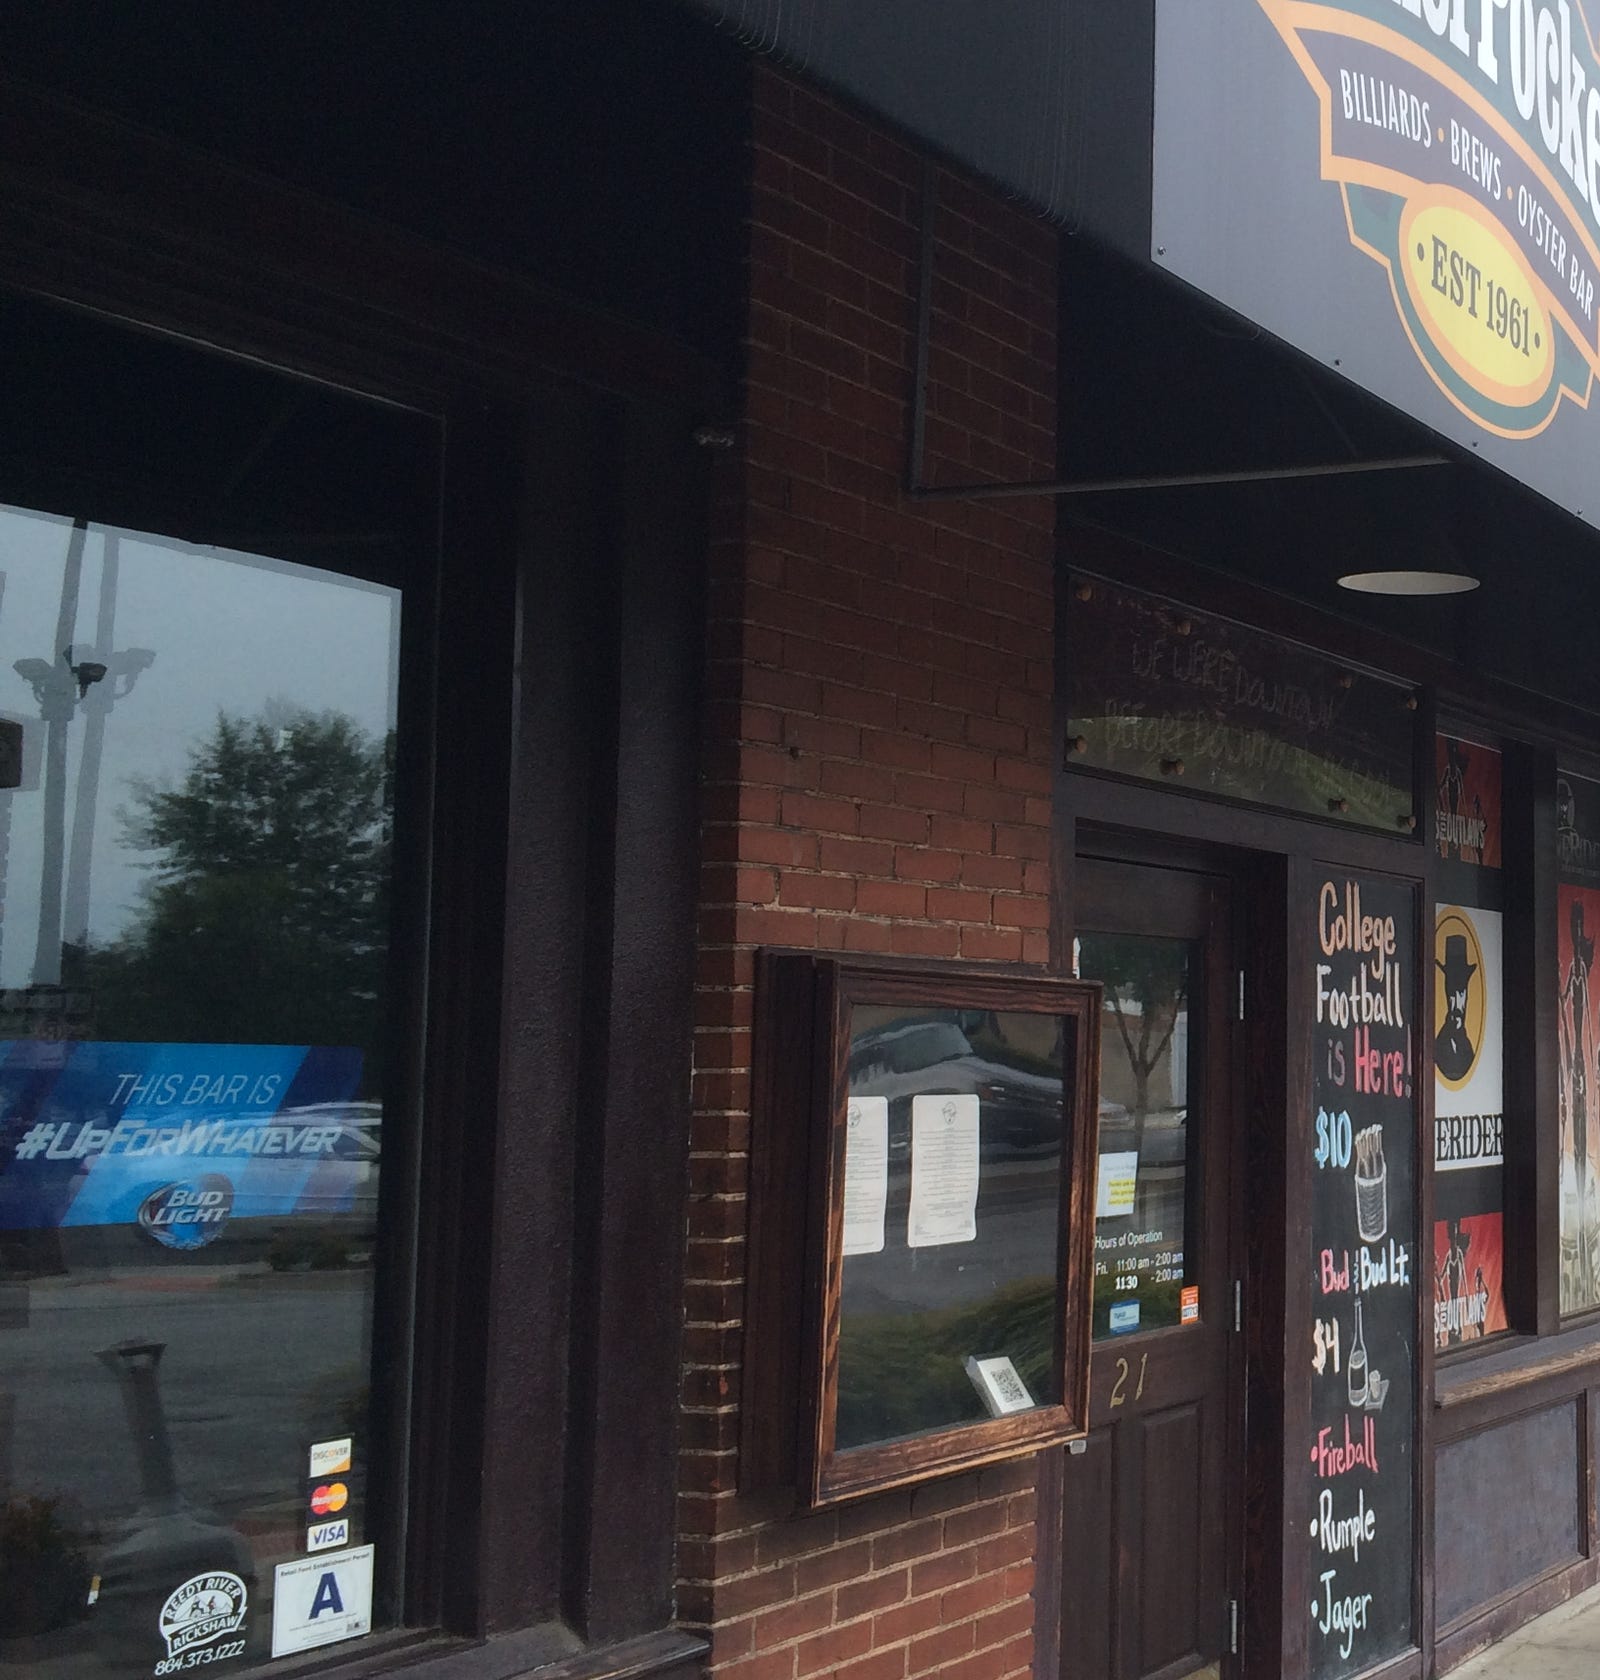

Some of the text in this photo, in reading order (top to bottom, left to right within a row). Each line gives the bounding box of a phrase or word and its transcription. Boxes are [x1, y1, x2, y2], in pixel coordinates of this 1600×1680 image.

[1340, 68, 1595, 321] BILLIARDS BREWS OYSTER BAR
[1431, 234, 1531, 357] EST 1961
[1447, 813, 1486, 849] OUTLAWS
[1318, 880, 1396, 980] College
[1315, 961, 1404, 1030] Football
[1327, 1024, 1412, 1099] is Here!
[109, 1073, 283, 1106] THIS BAR IS
[1314, 1106, 1352, 1169] $10
[153, 1207, 229, 1226] LIGHT
[1094, 1231, 1163, 1249] Hours of Operation
[1115, 1275, 1138, 1290] 11:30
[1155, 1268, 1172, 1283] 2:00
[1172, 1268, 1184, 1280] am
[1117, 1257, 1137, 1272] 11:00
[1138, 1257, 1150, 1268] am
[1155, 1252, 1171, 1266] 2:00
[1172, 1252, 1184, 1263] am
[1320, 1248, 1350, 1295] Bud
[1361, 1245, 1388, 1291] Bud
[1447, 1291, 1488, 1335] OUTLAWS
[1311, 1317, 1340, 1376] $4
[1110, 1352, 1148, 1409] 21
[313, 1447, 349, 1461] DISCOVER
[1317, 1413, 1379, 1477] Fireball
[313, 1524, 346, 1545] VISA
[1320, 1488, 1375, 1563] Rumple
[165, 1575, 242, 1620] REEDY RIVER
[308, 1572, 344, 1620] A
[1319, 1569, 1373, 1660] Jager
[172, 1614, 241, 1651] RICKSHAW
[154, 1640, 246, 1677] 864.373.1222
